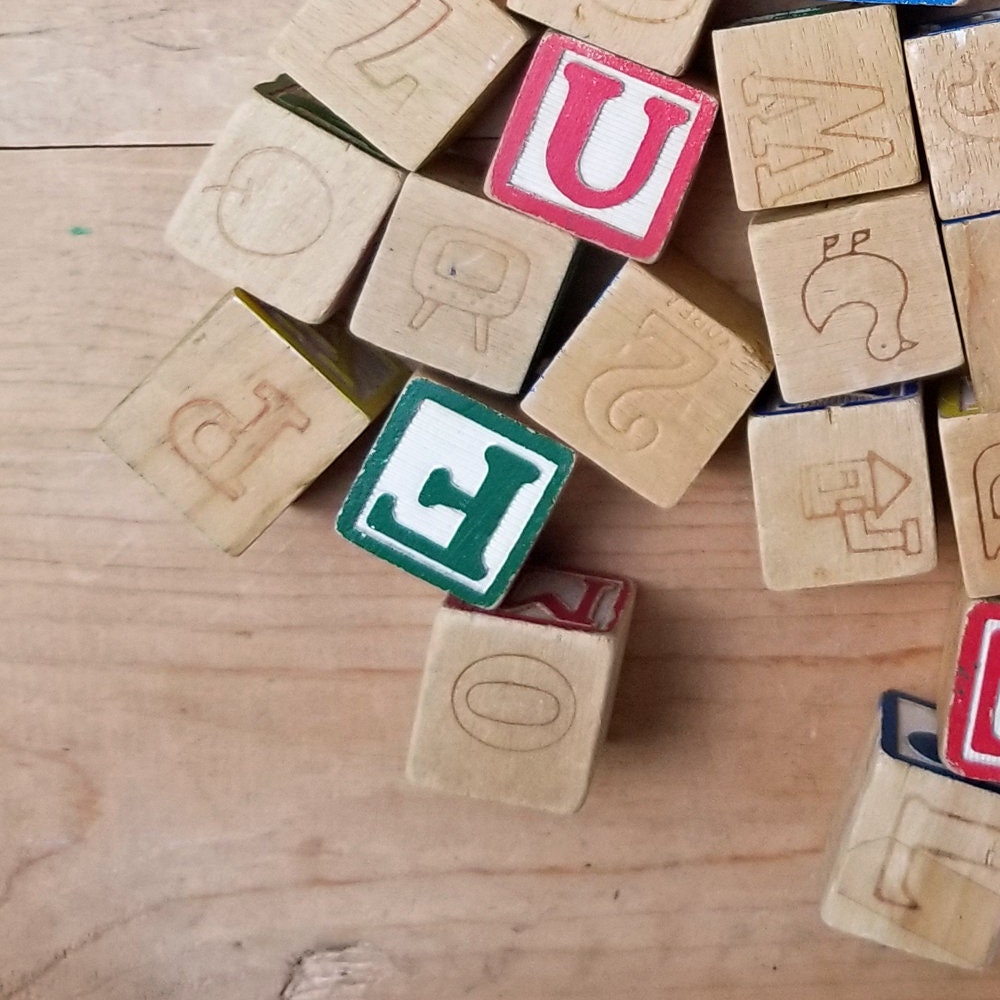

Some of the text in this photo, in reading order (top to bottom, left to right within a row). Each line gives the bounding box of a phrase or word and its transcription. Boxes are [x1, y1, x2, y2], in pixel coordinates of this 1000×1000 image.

[546, 61, 691, 210] U
[167, 379, 310, 501] P
[366, 444, 542, 582] F
